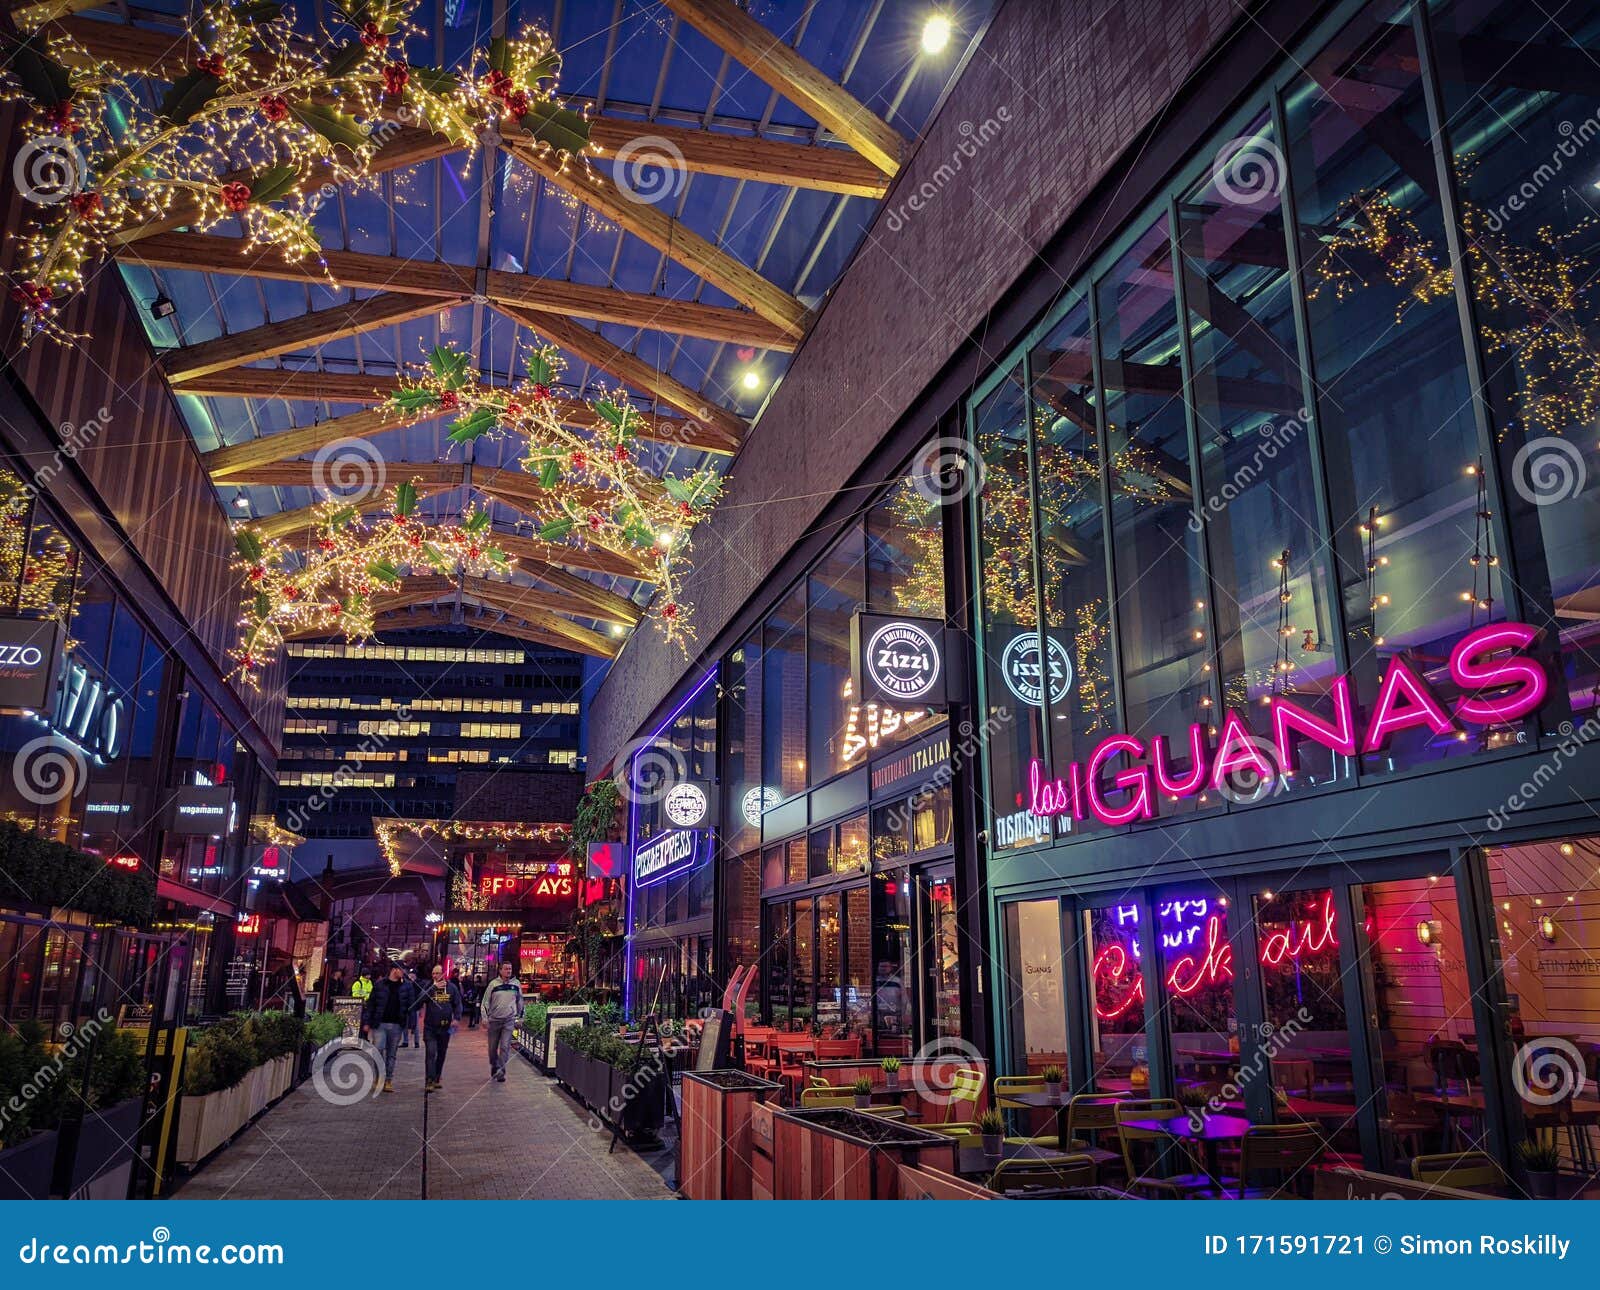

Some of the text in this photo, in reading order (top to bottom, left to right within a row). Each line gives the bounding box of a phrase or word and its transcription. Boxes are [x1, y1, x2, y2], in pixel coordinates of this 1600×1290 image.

[881, 629, 926, 647] INDIVIDUALLY
[878, 649, 930, 671] Zizzi
[882, 675, 926, 692] ITALIAN
[1030, 759, 1068, 817] las
[1070, 621, 1548, 827] IGUANAS
[180, 805, 224, 816] wagamama
[635, 829, 692, 879] PIZZAEXPRESS
